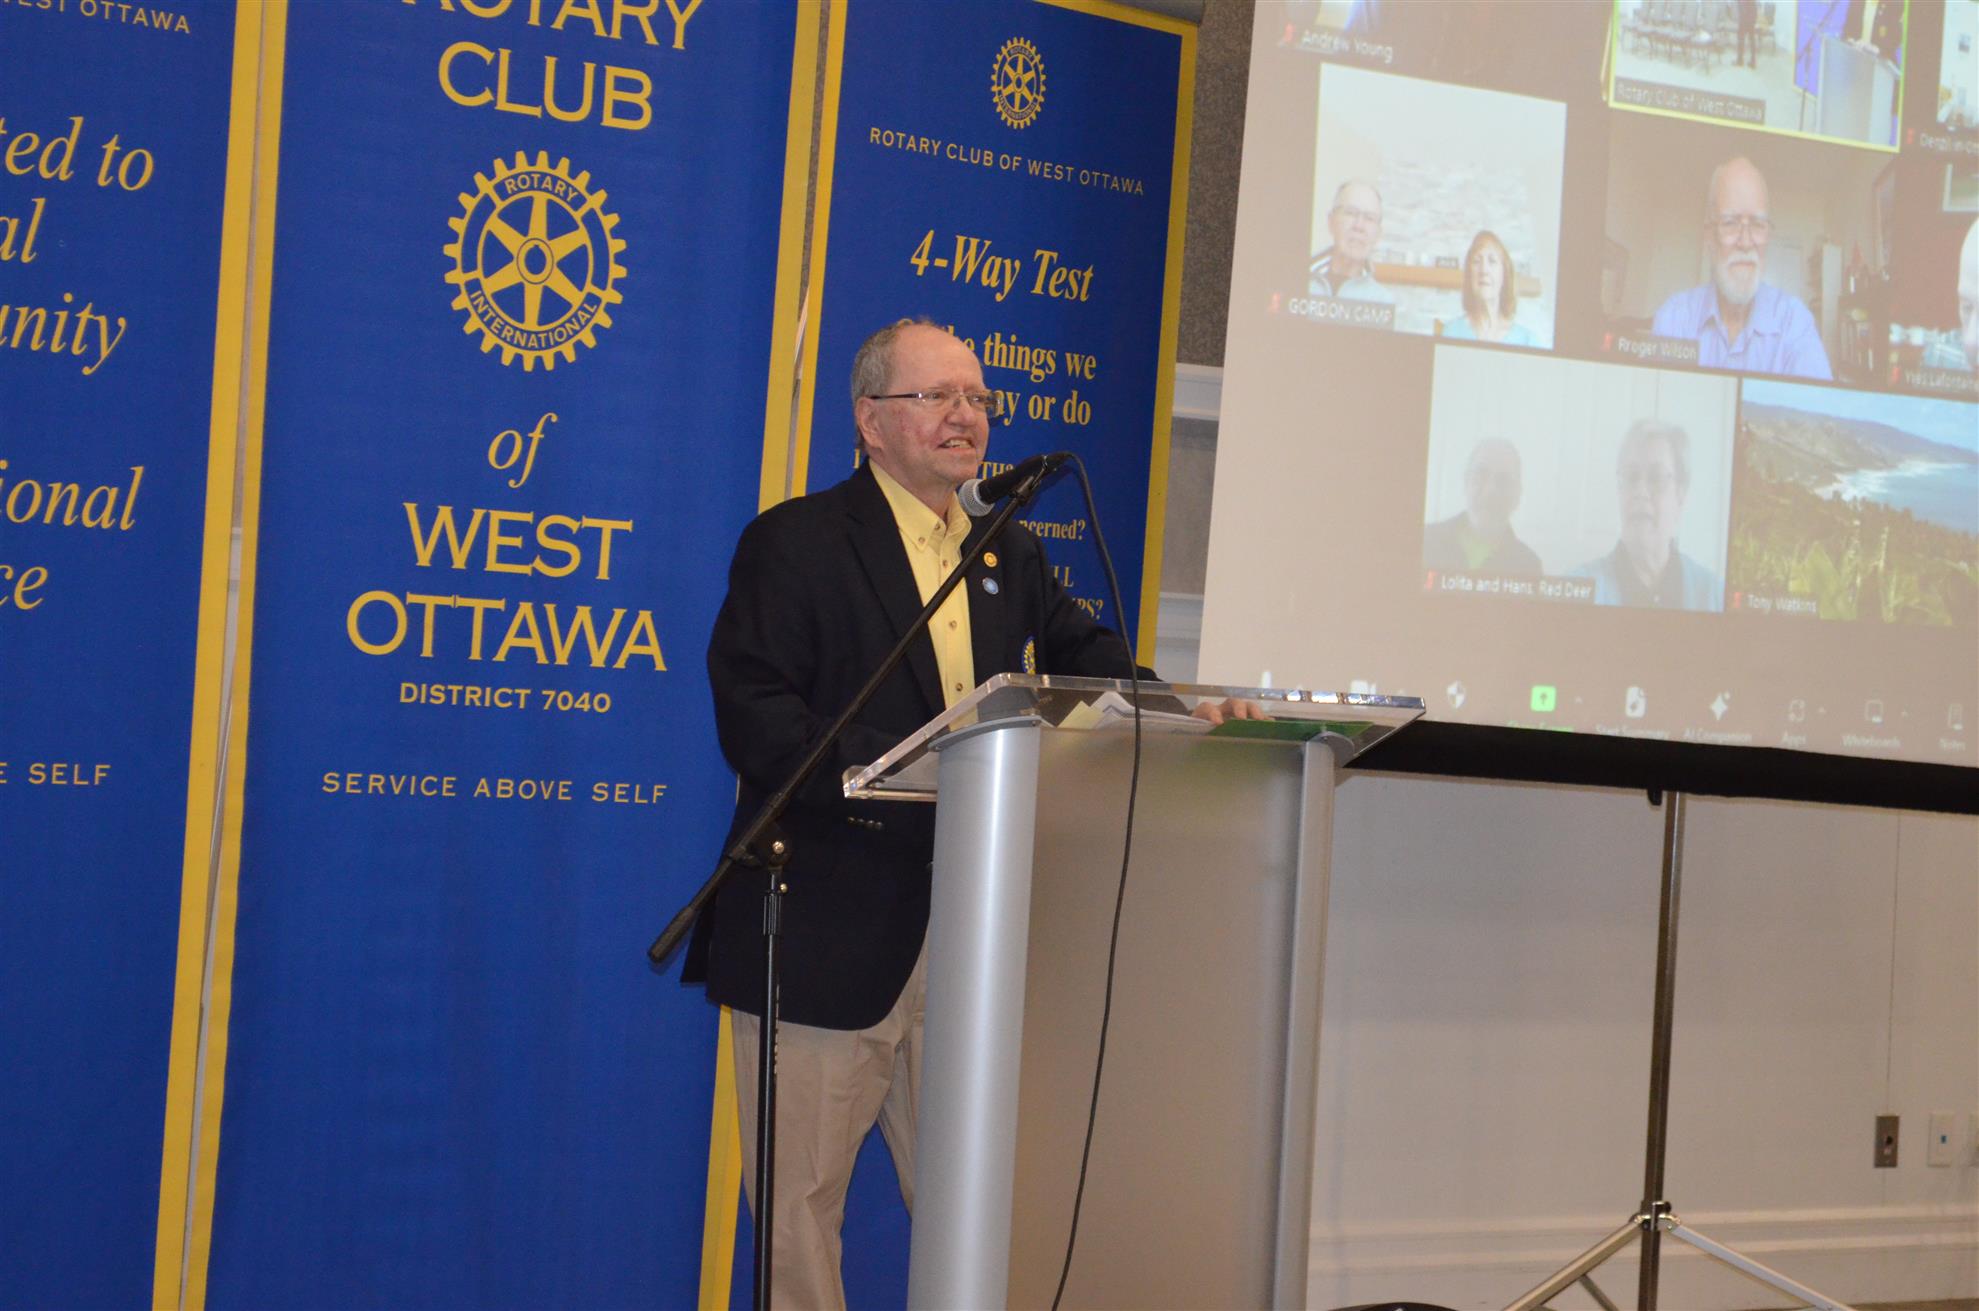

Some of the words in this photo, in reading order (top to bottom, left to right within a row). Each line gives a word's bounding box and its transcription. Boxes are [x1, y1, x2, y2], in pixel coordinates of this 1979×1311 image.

[80, 0, 190, 34] OTTAWA
[401, 0, 702, 49] ARY
[1355, 37, 1393, 65] Young
[438, 41, 653, 131] CLUB
[0, 116, 84, 182] ed
[97, 134, 155, 191] to
[869, 127, 941, 156] ROTARY
[946, 143, 994, 167] CLUB
[999, 154, 1022, 172] OF
[1027, 159, 1074, 182] WEST
[1079, 170, 1144, 195] OTTAWA
[503, 173, 579, 202] ROTARY
[910, 230, 1021, 302] 4-Way
[1031, 249, 1095, 302] Test
[470, 290, 598, 349] INTERNATIONAL
[1288, 297, 1350, 320] GORDON
[1354, 305, 1393, 324] CAMP
[983, 332, 1057, 383] things
[1065, 352, 1097, 381] we
[1660, 342, 1697, 360] Wilson
[1028, 394, 1057, 421] or
[1062, 389, 1092, 426] do
[488, 412, 558, 488] of
[403, 502, 633, 580] WEST
[1441, 575, 1473, 592] Lolita
[1476, 576, 1500, 593] and
[1539, 579, 1562, 597] Red
[1564, 582, 1593, 599] Deer
[346, 590, 667, 671] OTTAWA
[399, 682, 531, 710] DISTRICT
[542, 690, 611, 713] 7040
[28, 762, 111, 785] SELF
[322, 772, 456, 797] SERVICE
[473, 777, 573, 800] ABOVE
[591, 782, 667, 804] SELF
